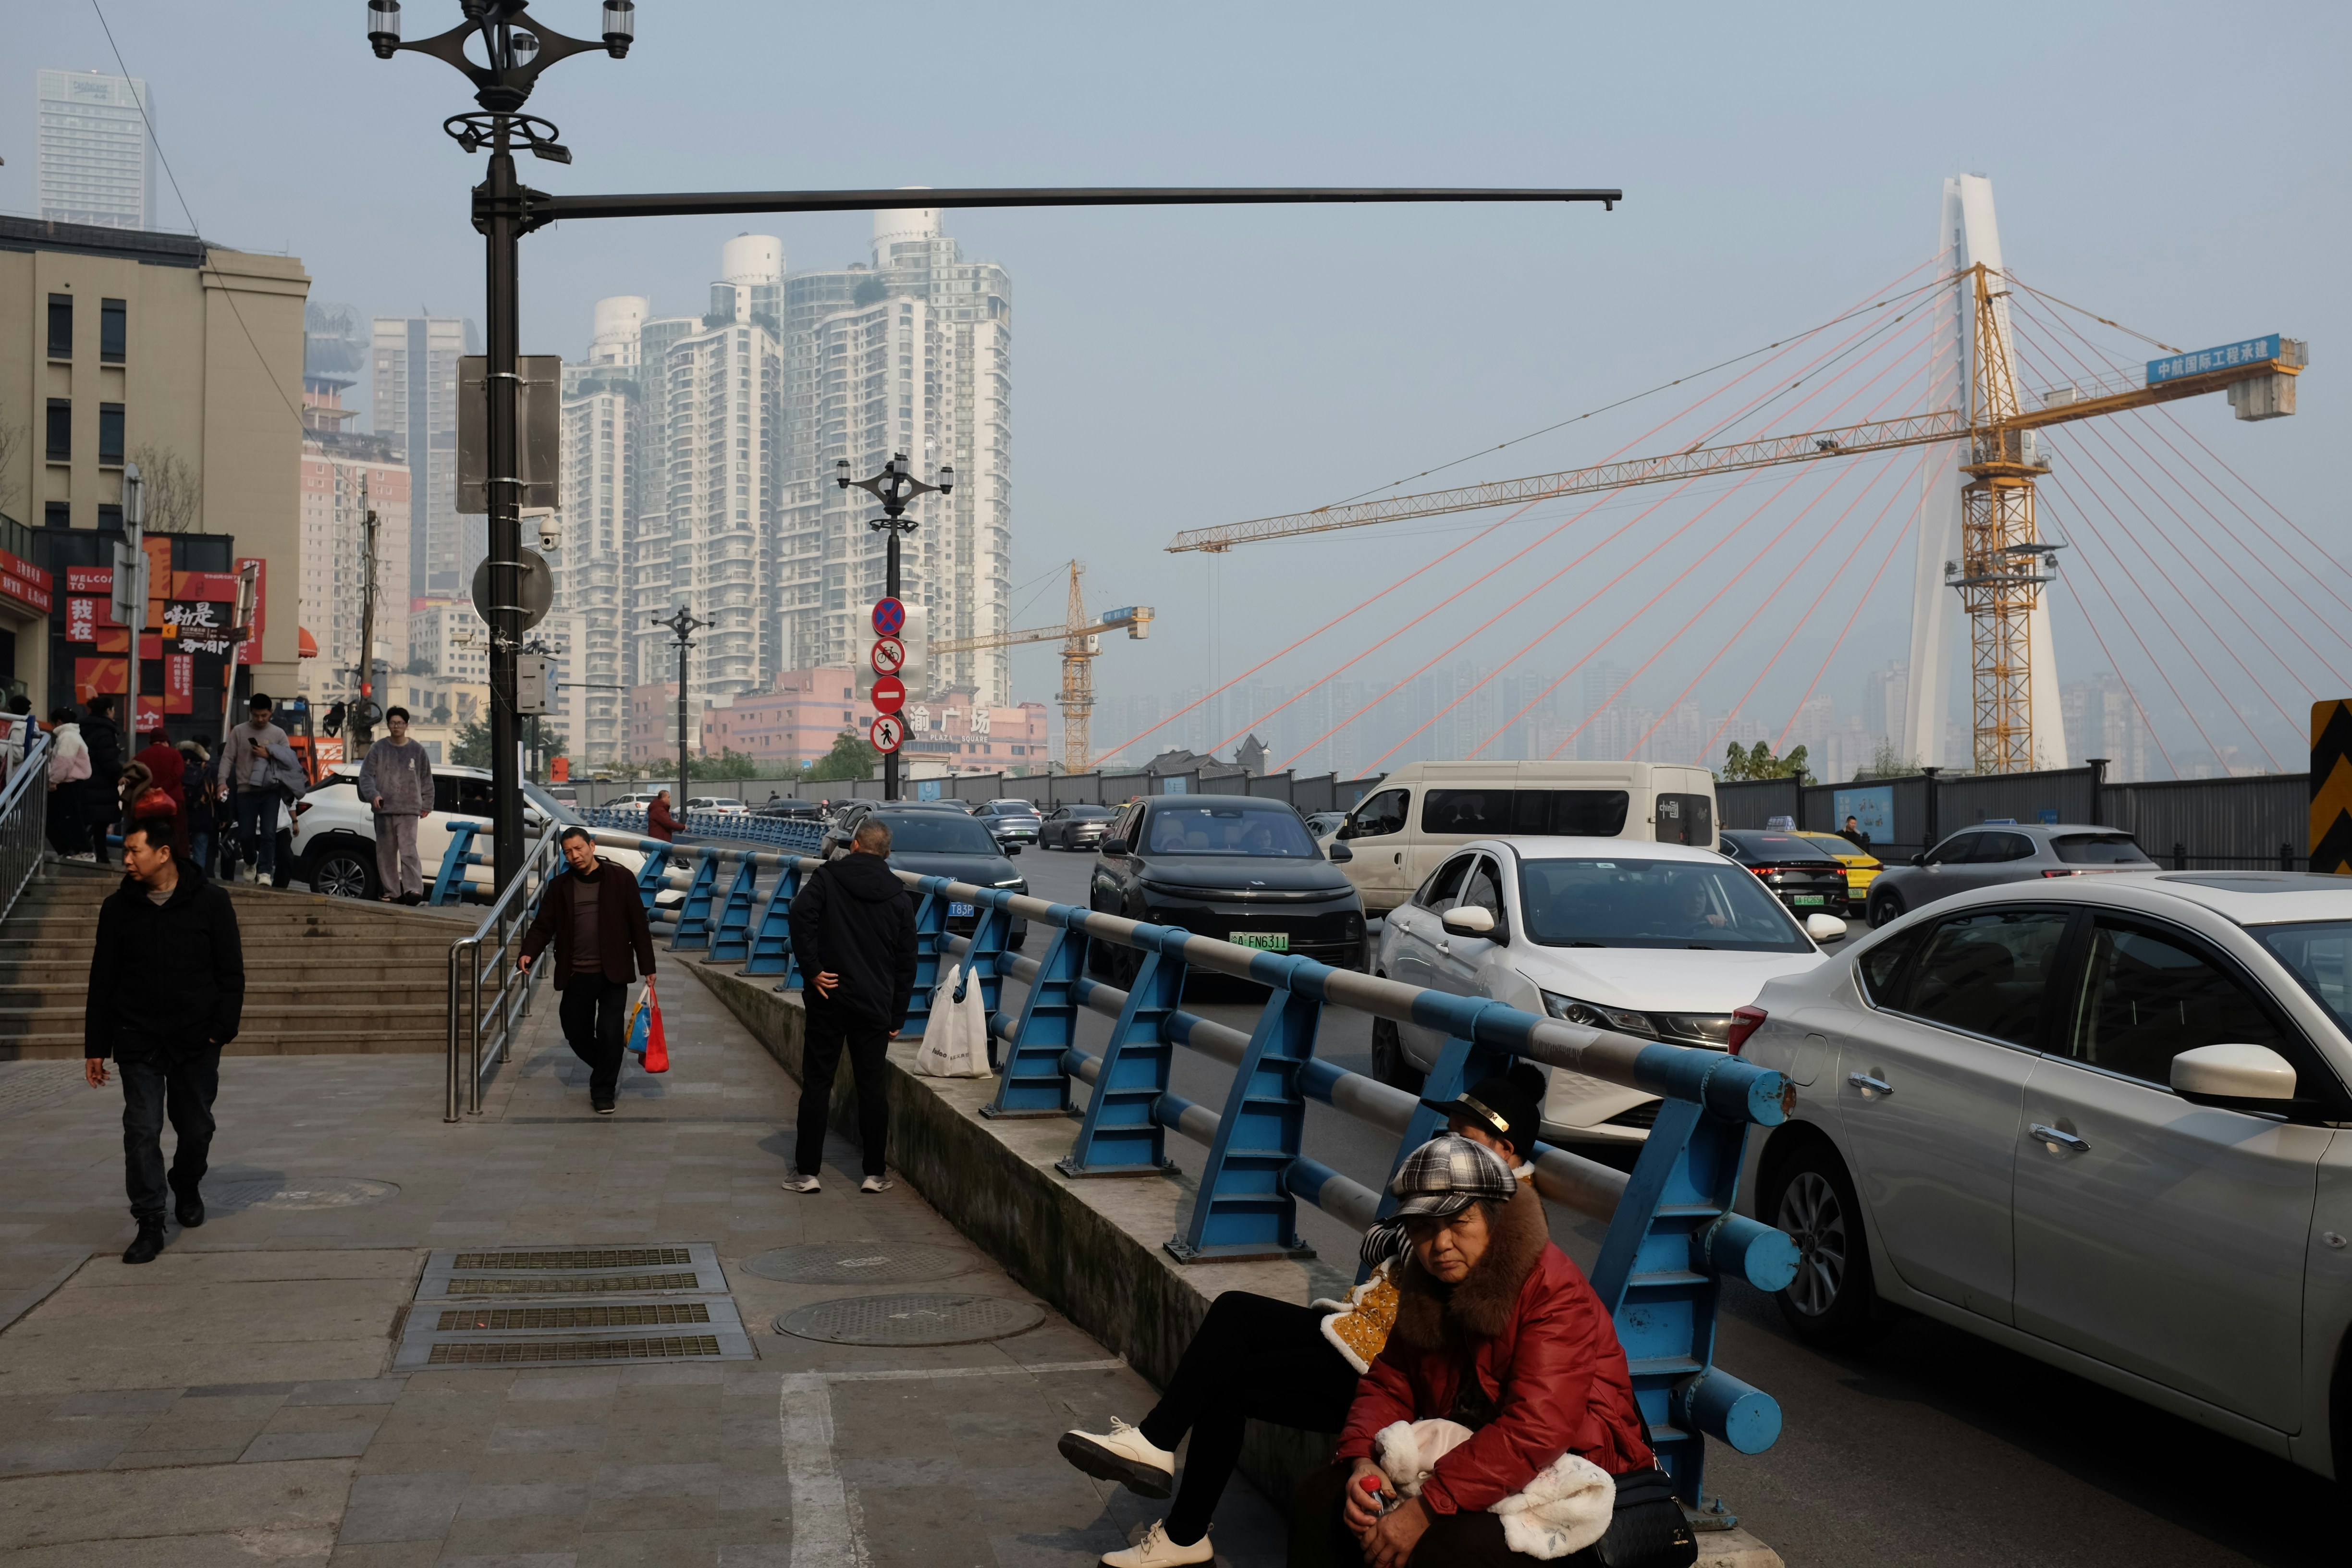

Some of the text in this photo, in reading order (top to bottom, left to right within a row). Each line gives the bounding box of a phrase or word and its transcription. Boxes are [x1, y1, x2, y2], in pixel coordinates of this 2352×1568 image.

[2158, 340, 2268, 379] 中航国际工程承建
[70, 599, 93, 640] 我在
[951, 905, 973, 914] T83P
[1249, 936, 1286, 948] FN6311
